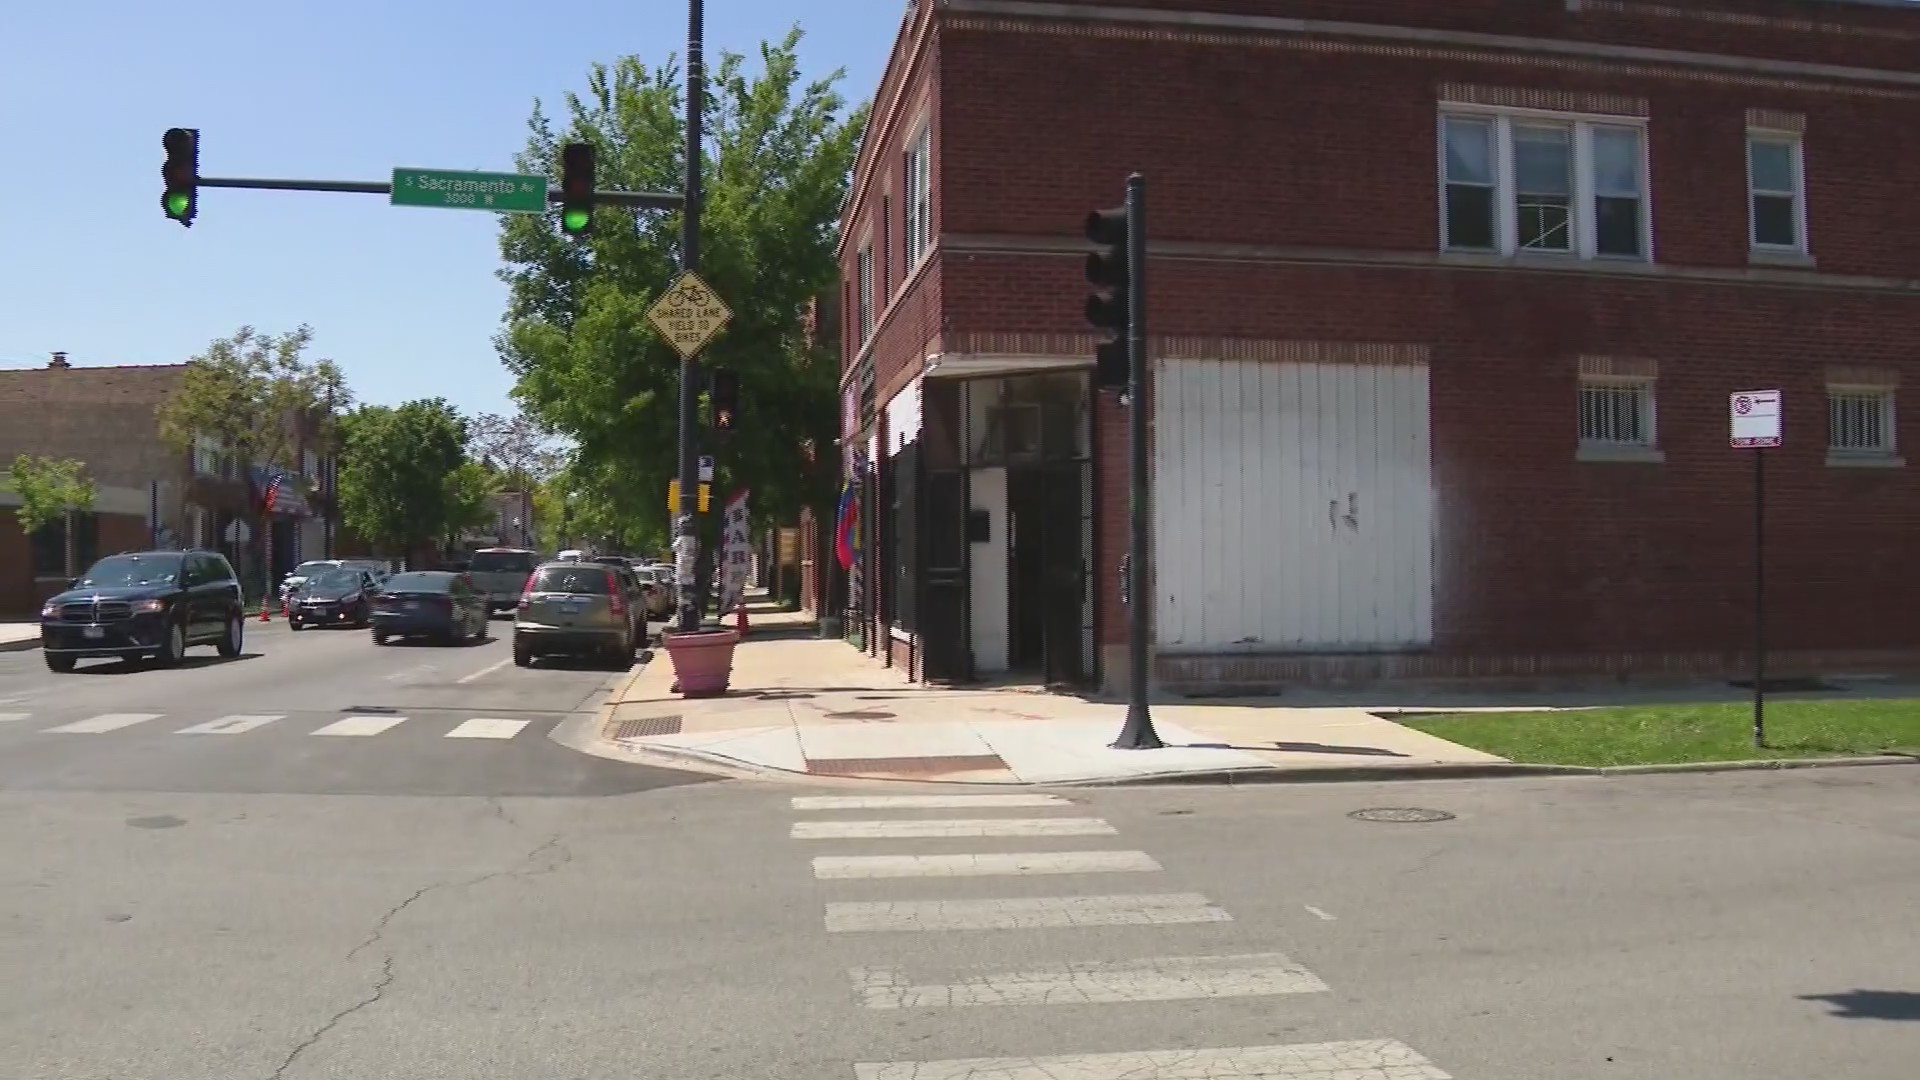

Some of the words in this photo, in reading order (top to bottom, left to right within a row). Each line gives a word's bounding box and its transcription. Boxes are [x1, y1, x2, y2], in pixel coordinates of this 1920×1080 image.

[405, 176, 413, 187] S
[418, 175, 516, 194] Sacramento
[520, 183, 535, 193] Av
[445, 192, 476, 205] 3000
[484, 195, 495, 206] W
[656, 308, 694, 319] SHARED
[696, 308, 720, 318] LANE
[668, 320, 695, 331] YIELD
[698, 320, 710, 331] TO
[674, 332, 701, 343] BIKES
